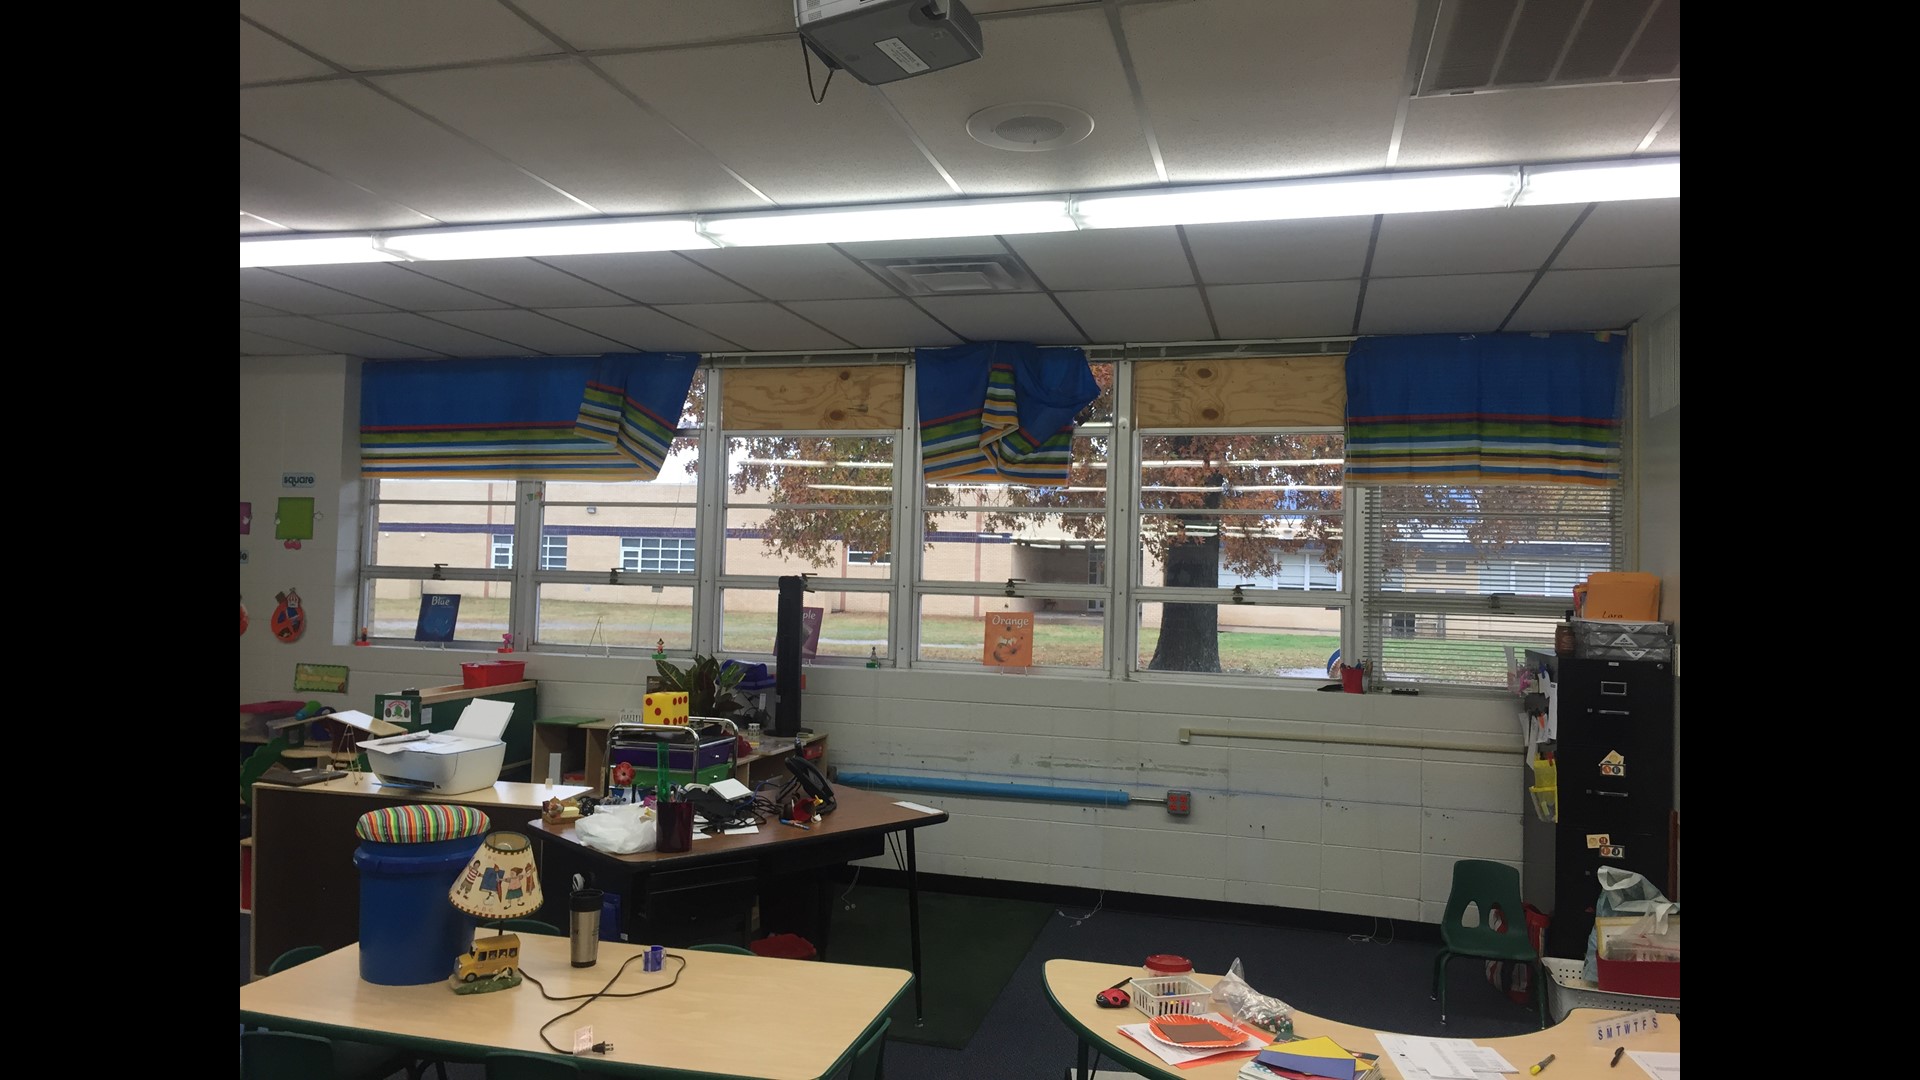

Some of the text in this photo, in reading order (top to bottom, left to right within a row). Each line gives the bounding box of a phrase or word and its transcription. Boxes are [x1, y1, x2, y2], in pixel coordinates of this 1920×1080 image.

[284, 476, 314, 487] square
[431, 595, 450, 606] Blue
[802, 610, 816, 622] ple
[992, 614, 1029, 629] Orange
